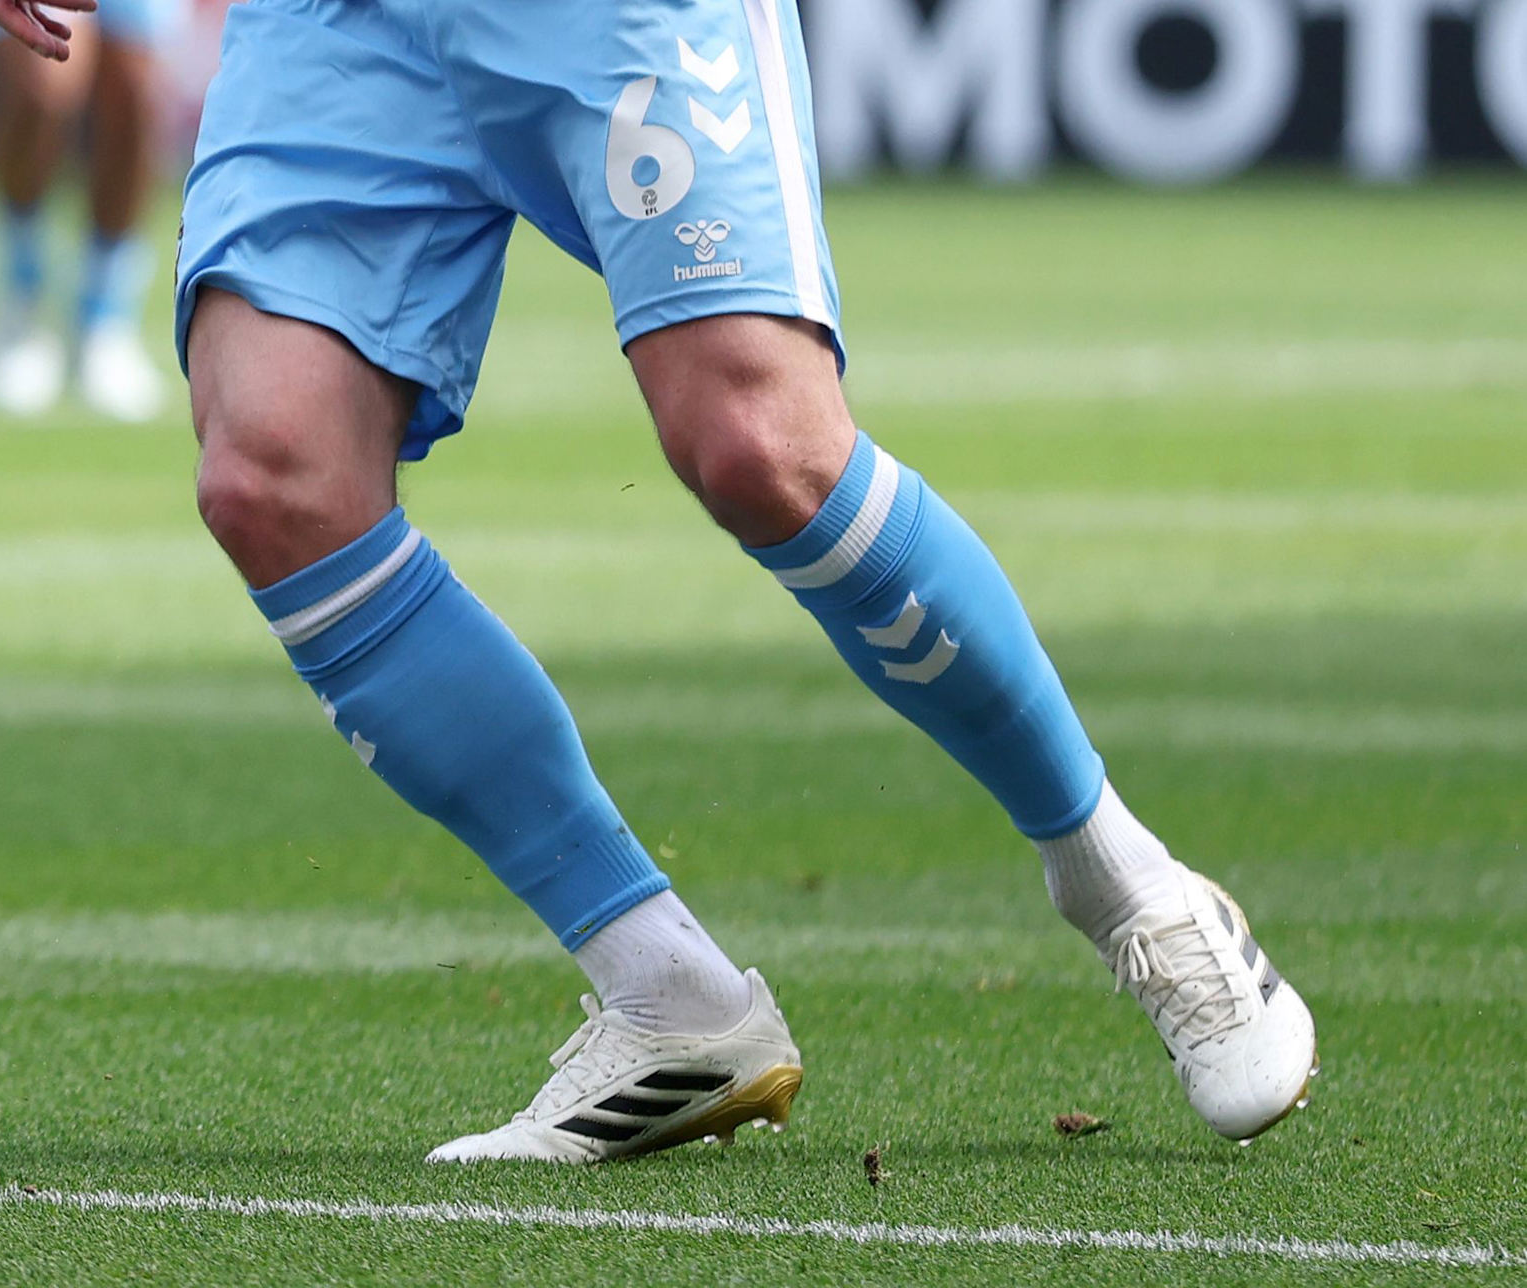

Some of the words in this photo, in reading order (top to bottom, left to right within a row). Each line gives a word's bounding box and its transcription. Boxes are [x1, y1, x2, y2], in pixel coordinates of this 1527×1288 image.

[605, 74, 696, 220] 6
[645, 207, 658, 216] EFL
[673, 258, 742, 281] hummel
